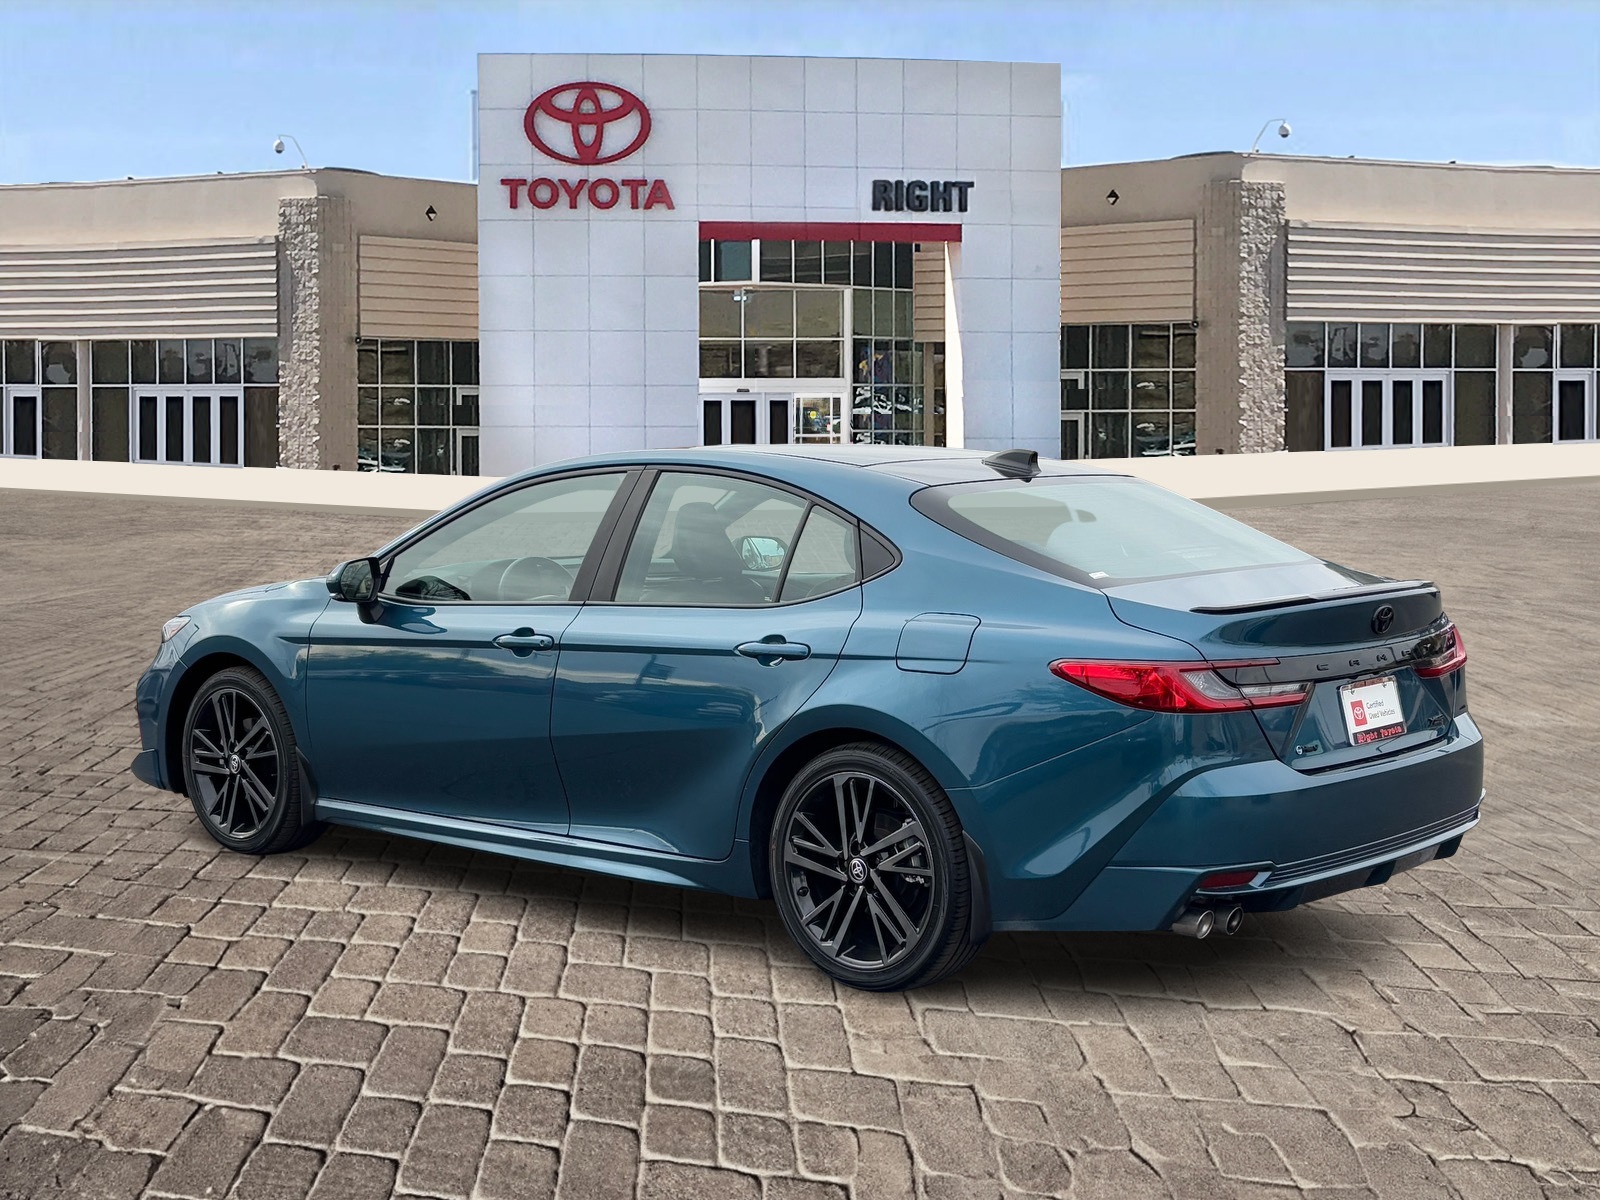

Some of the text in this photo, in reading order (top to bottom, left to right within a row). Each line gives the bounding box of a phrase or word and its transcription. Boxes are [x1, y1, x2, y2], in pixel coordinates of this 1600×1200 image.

[500, 178, 676, 210] TOYOTA
[871, 179, 975, 212] RIGHT
[1356, 725, 1403, 744] Right Toyota
